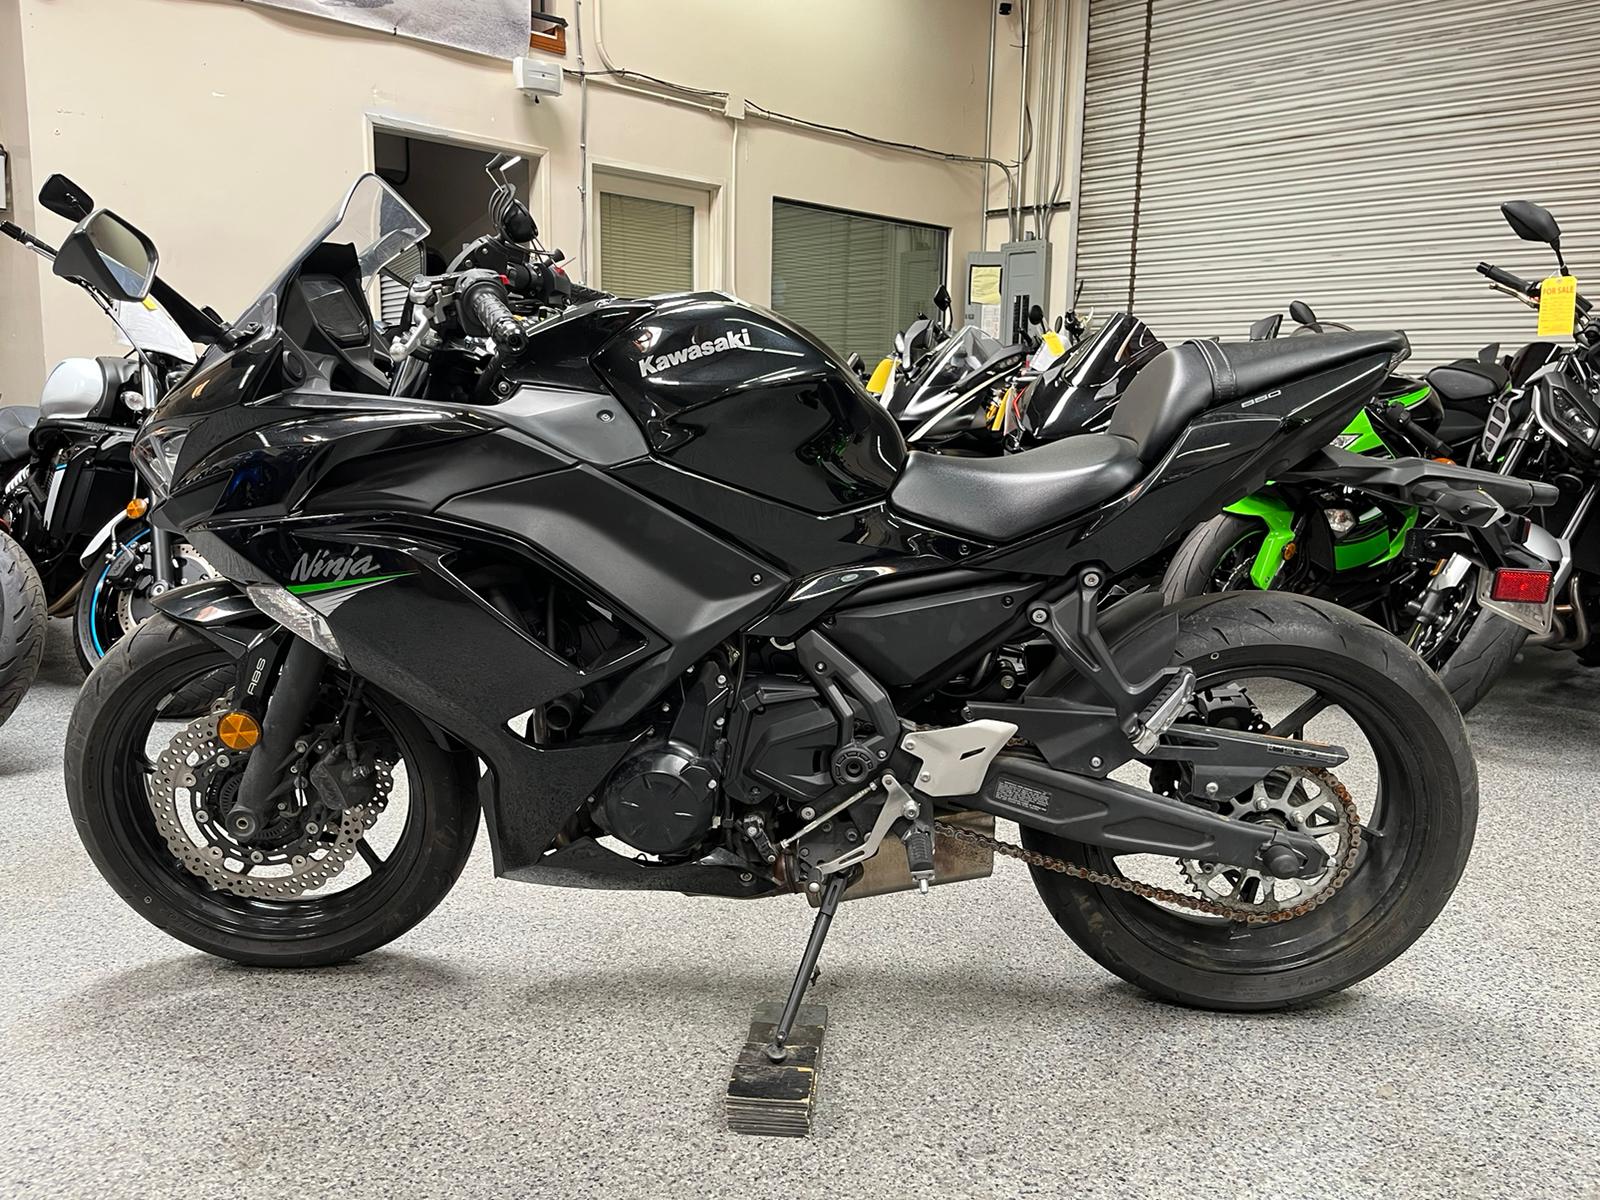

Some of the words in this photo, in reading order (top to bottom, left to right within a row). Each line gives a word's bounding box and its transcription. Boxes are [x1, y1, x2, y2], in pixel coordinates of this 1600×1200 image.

[1542, 287, 1557, 295] FOR
[1558, 286, 1574, 294] SALE
[638, 328, 751, 378] Kawasaki
[290, 545, 381, 582] Ninja
[247, 657, 266, 695] ABS
